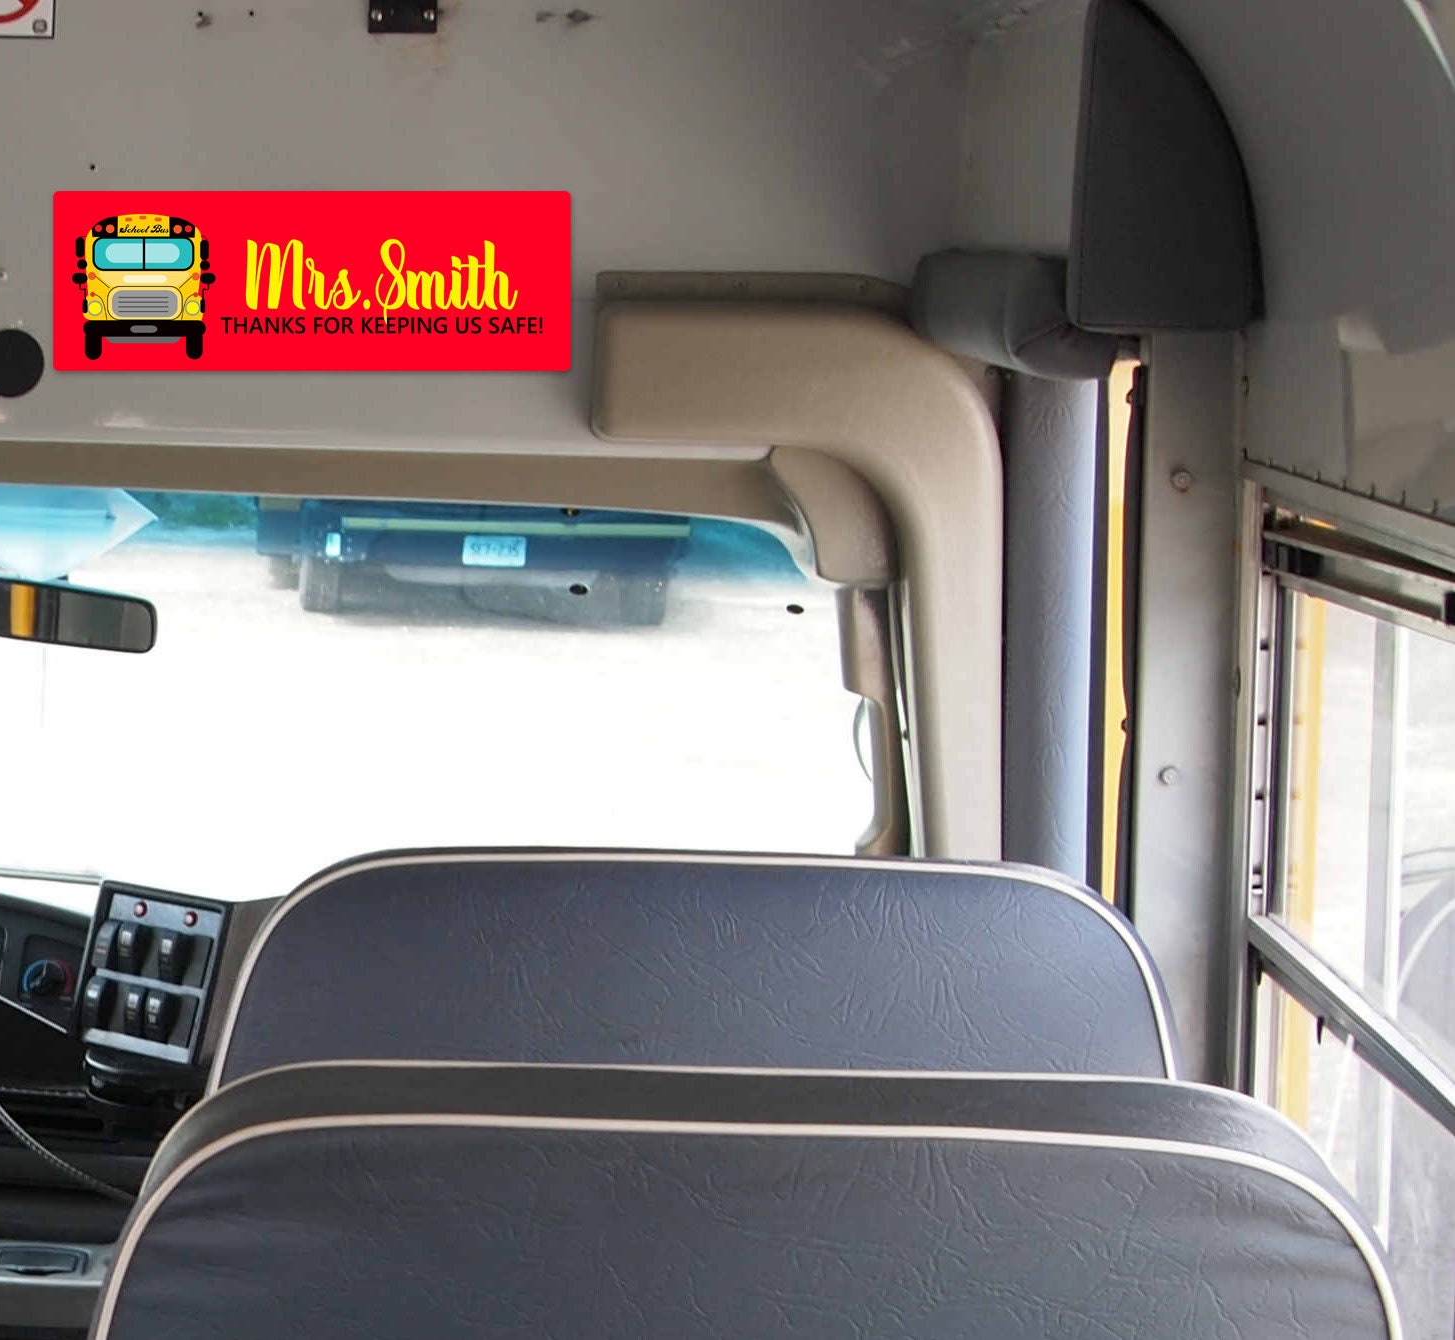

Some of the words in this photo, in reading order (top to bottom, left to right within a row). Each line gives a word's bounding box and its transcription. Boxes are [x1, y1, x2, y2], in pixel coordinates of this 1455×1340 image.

[119, 224, 150, 234] School
[150, 224, 169, 234] Bus
[220, 316, 306, 335] THANKS
[313, 316, 355, 335] FOR
[361, 316, 448, 335] KEEPING
[455, 316, 482, 335] US
[488, 316, 545, 335] SAFE!
